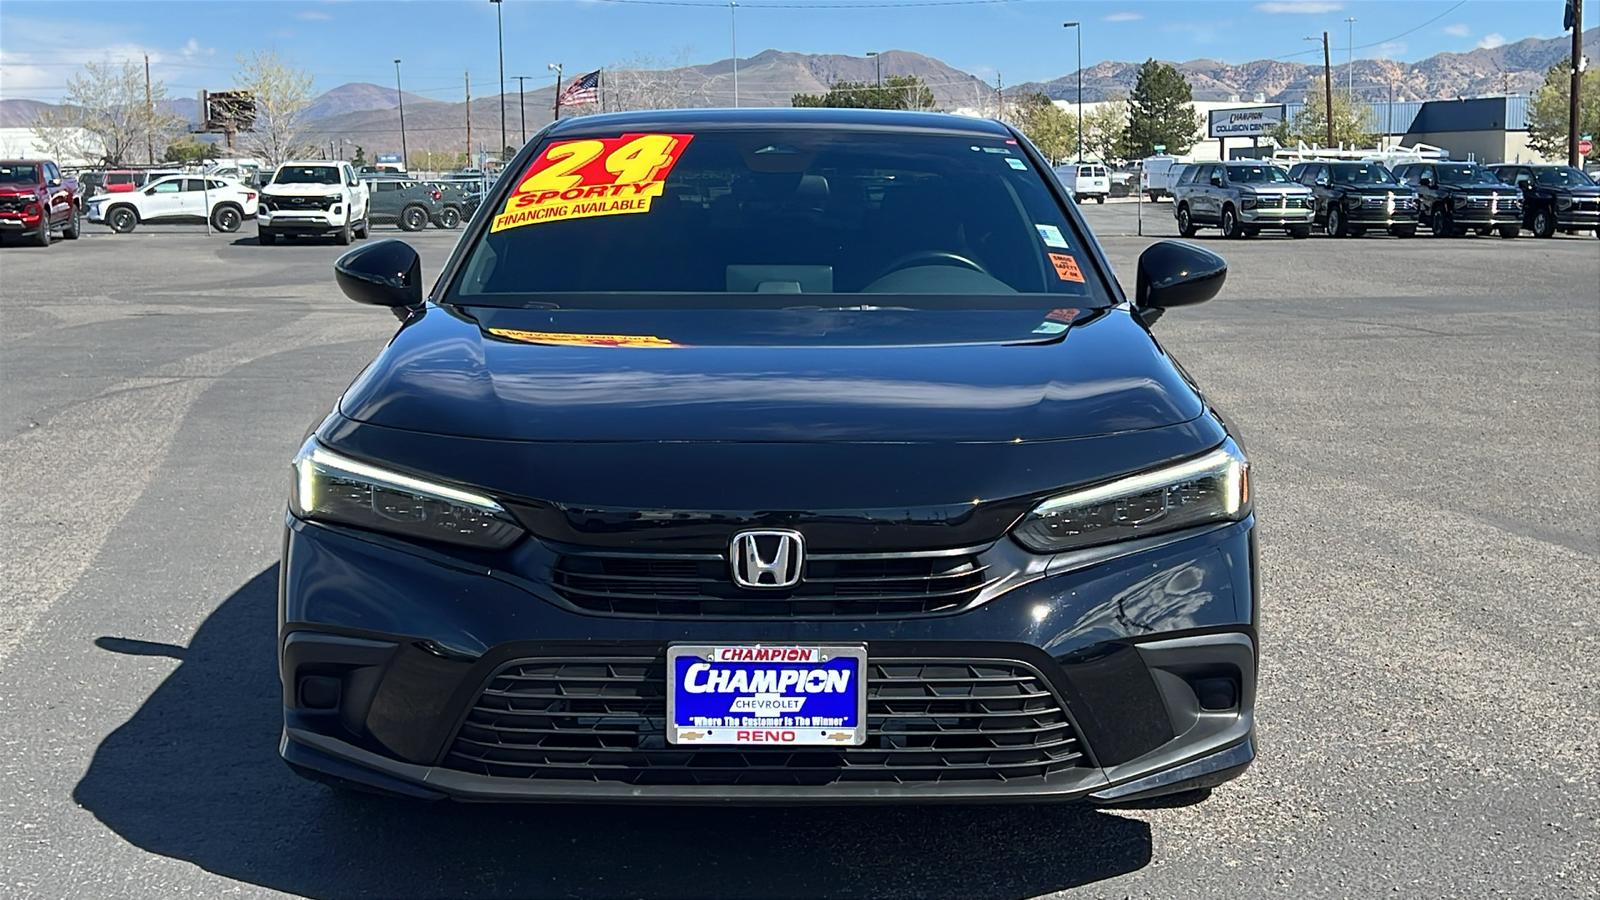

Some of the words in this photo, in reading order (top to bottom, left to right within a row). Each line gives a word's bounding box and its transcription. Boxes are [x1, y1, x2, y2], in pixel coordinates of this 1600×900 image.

[1230, 112, 1263, 124] CHAMPION
[1216, 124, 1248, 133] COLLISION
[519, 135, 678, 193] 24
[515, 183, 655, 208] SPORTY
[496, 205, 567, 228] FINANCING
[571, 198, 647, 214] AVAILABLE
[721, 648, 812, 661] CHAMPION
[683, 663, 851, 693] CHAMPION
[735, 700, 799, 709] CHEVROLET
[724, 717, 740, 726] The
[742, 717, 783, 726] Customer
[795, 717, 810, 726] The
[737, 731, 796, 742] RENO
